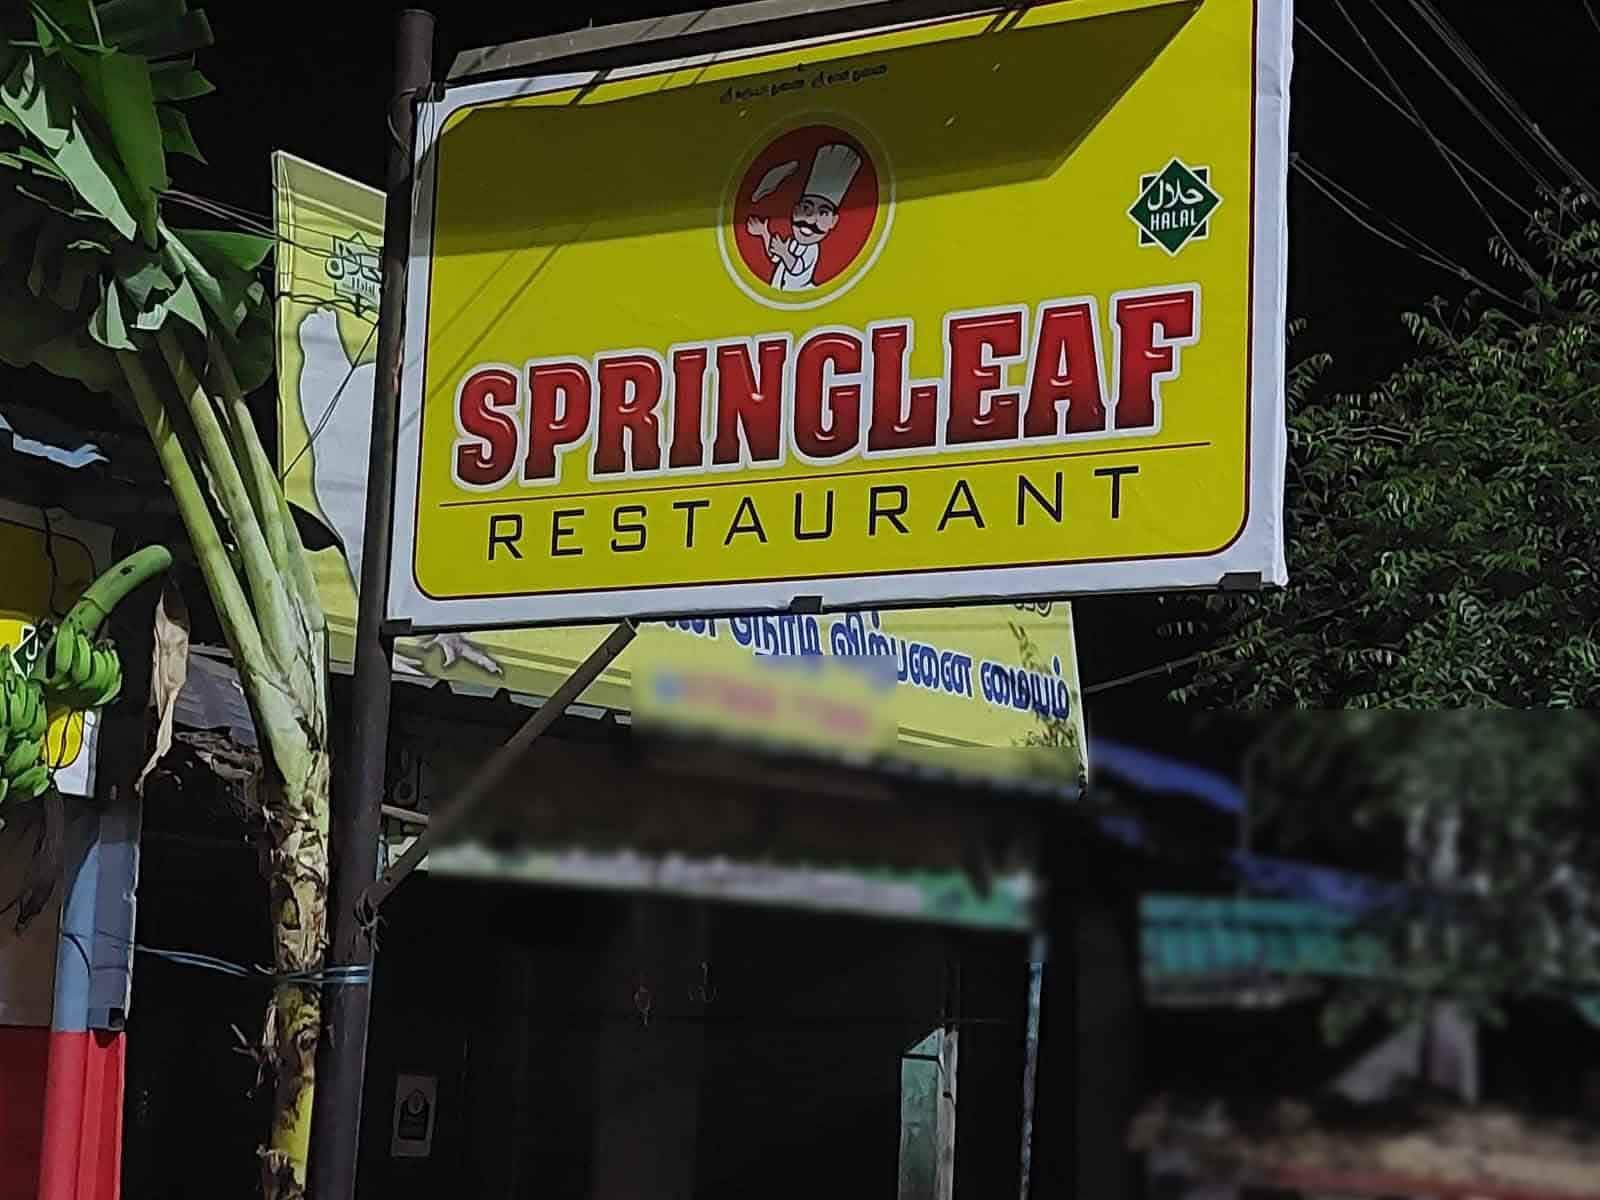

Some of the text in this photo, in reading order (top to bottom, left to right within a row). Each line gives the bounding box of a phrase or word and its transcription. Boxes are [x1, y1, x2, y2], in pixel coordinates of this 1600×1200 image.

[1146, 177, 1204, 211] حلال
[1149, 208, 1198, 232] HALAL
[455, 288, 1197, 490] SPRINGLEAF
[486, 465, 1141, 561] RESTAURANT
[980, 655, 1071, 721] மையம்
